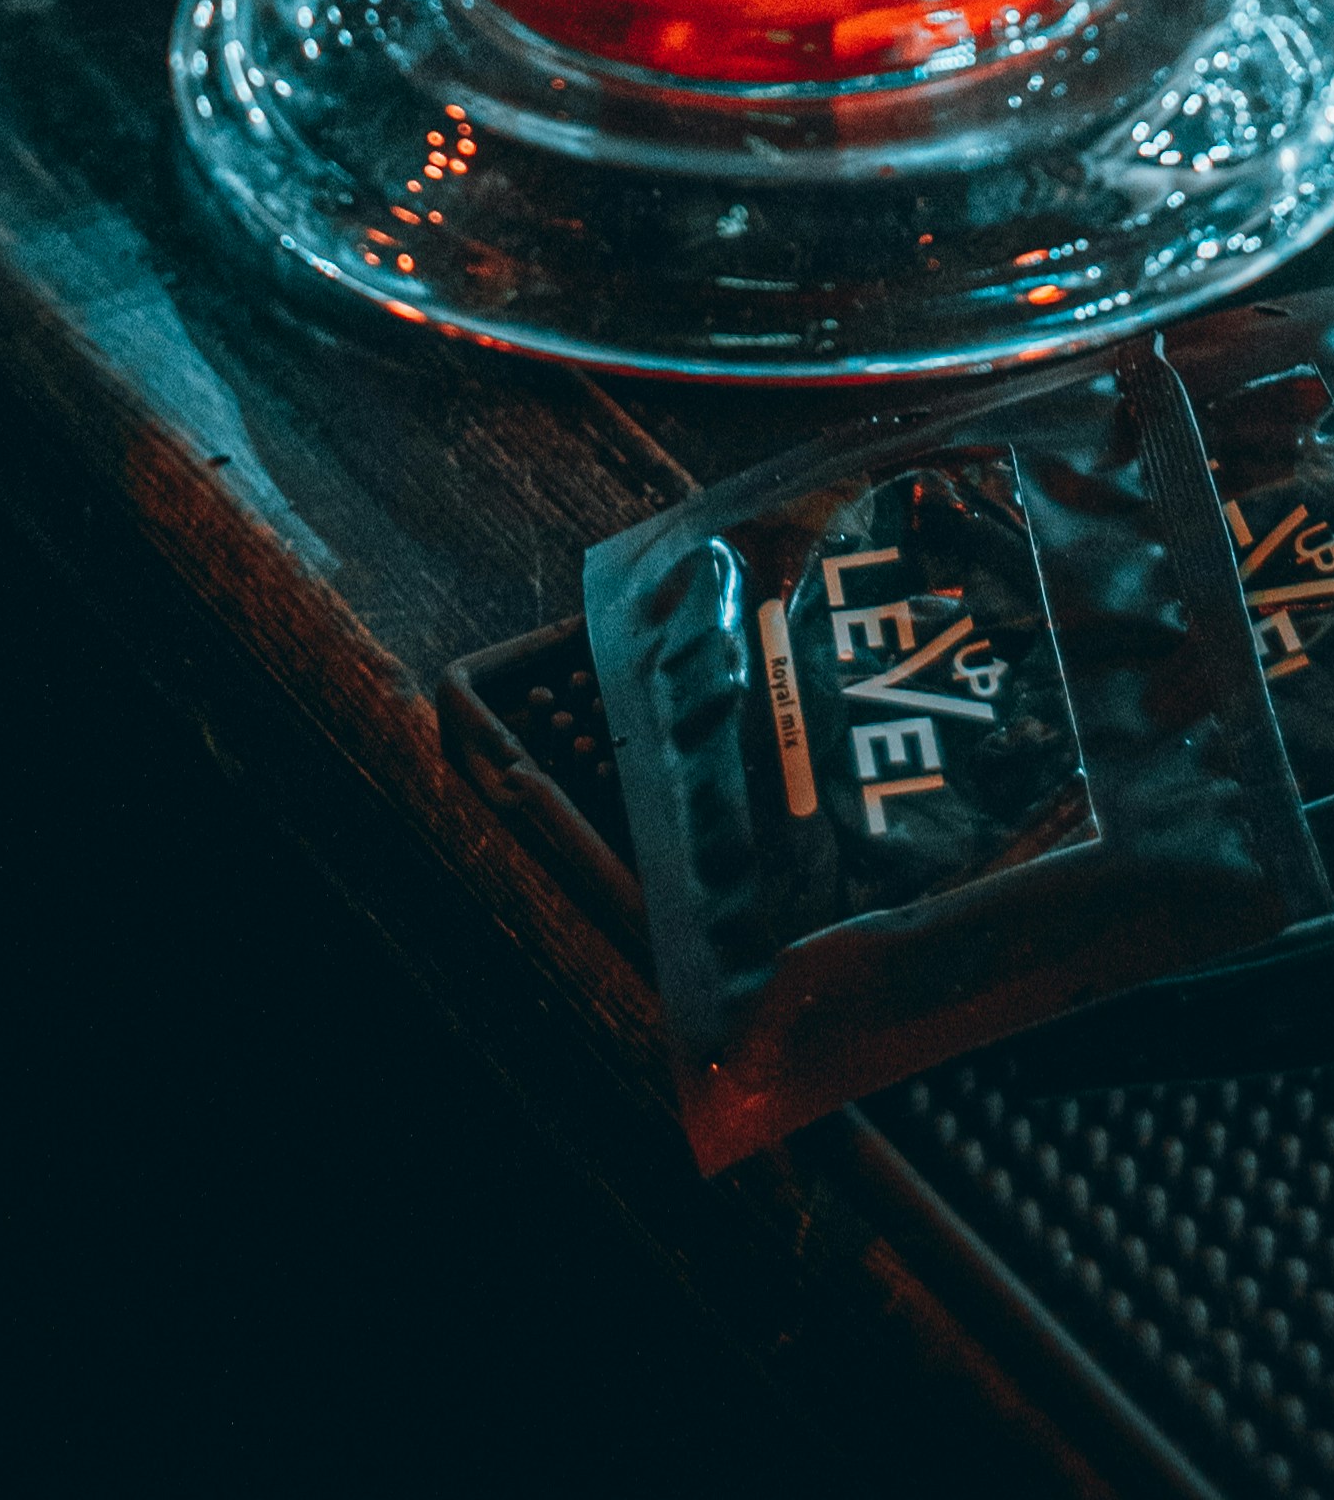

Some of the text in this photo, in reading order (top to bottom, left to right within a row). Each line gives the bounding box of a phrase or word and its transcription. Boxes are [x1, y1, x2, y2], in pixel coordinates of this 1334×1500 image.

[770, 656, 799, 749] Royal mix
[821, 546, 994, 836] LEVEL
[951, 638, 1009, 697] UP
